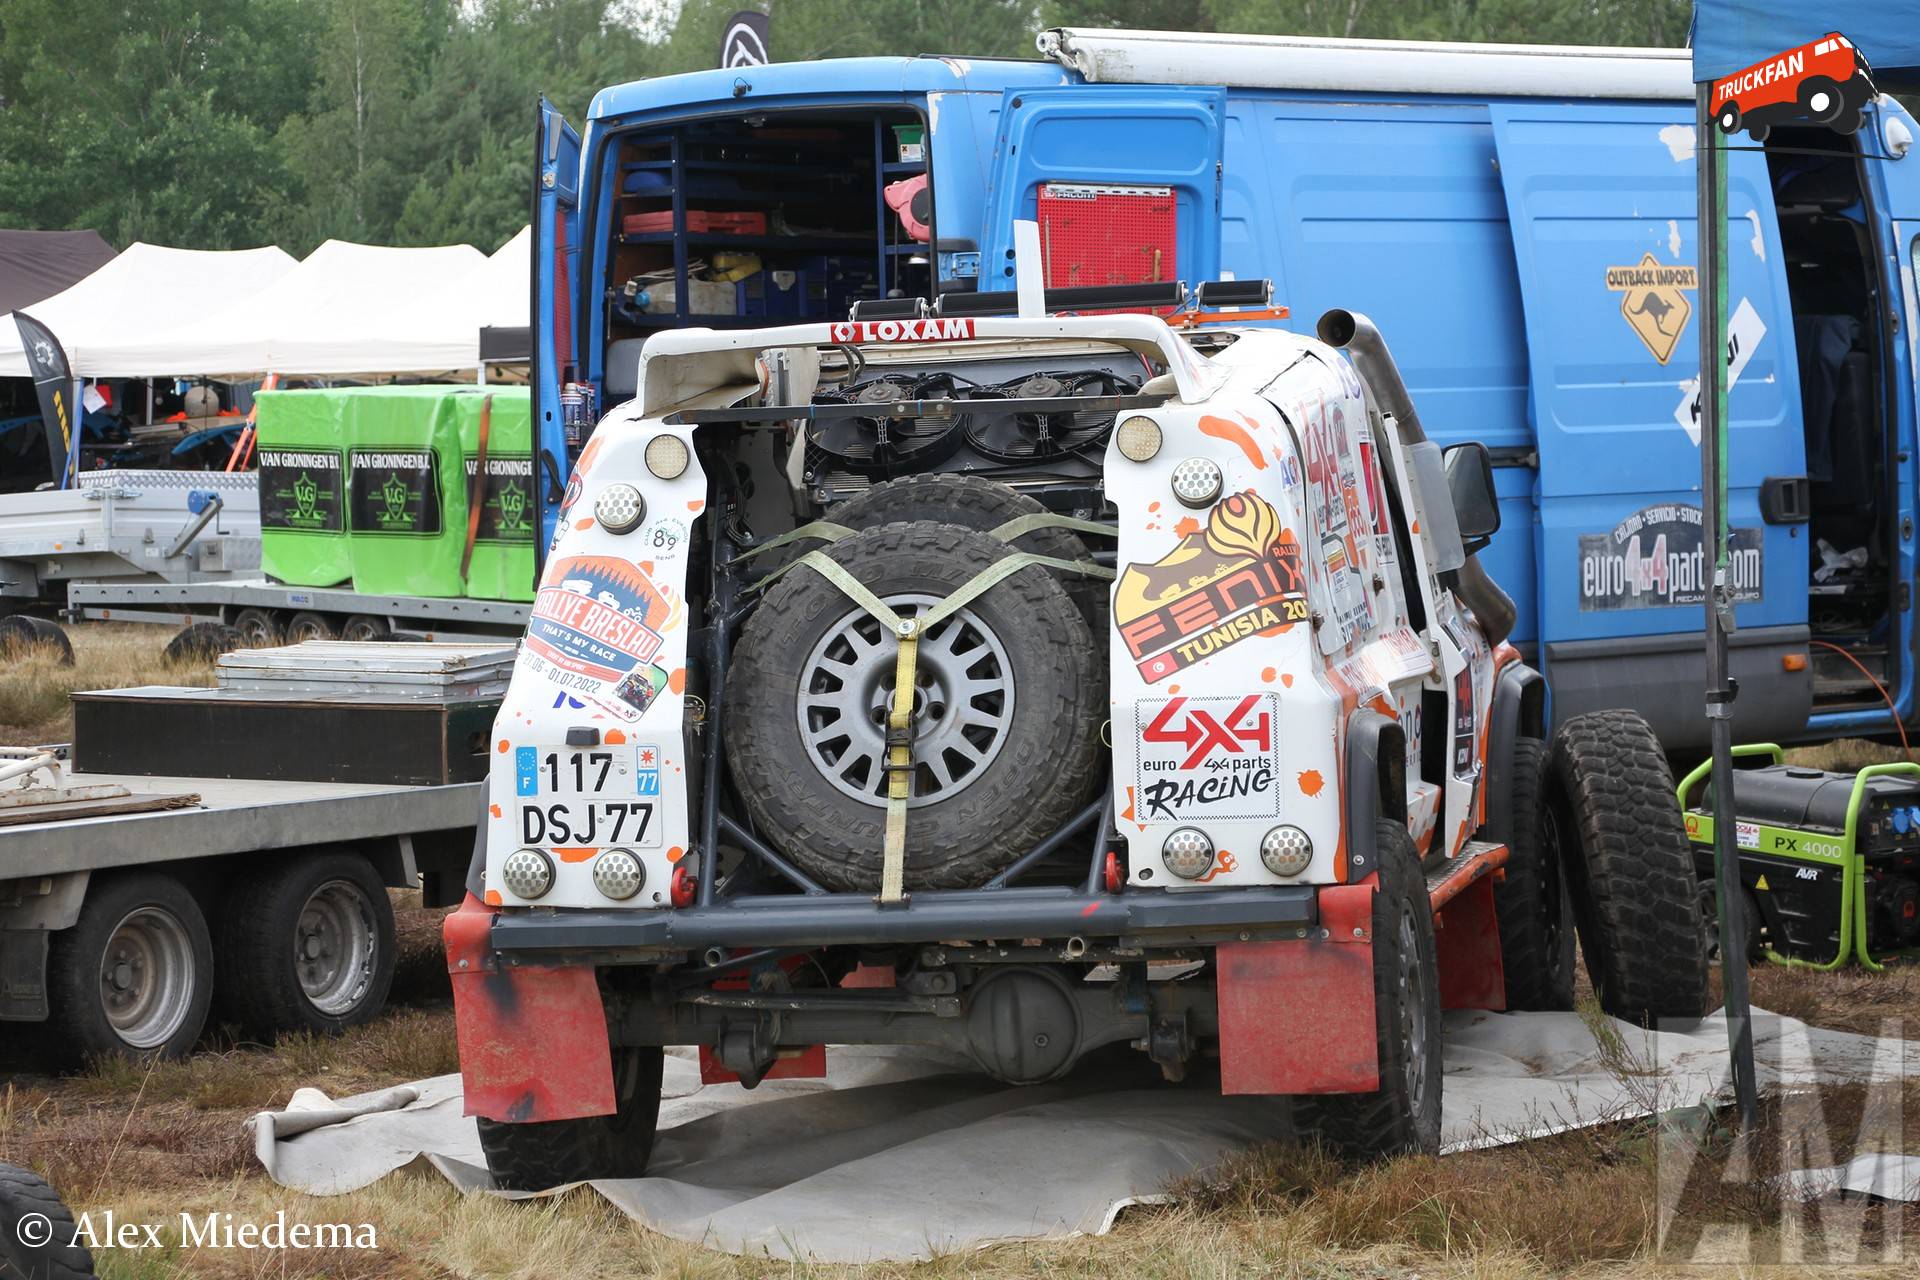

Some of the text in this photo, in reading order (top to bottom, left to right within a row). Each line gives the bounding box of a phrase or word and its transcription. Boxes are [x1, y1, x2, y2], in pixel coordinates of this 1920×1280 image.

[1607, 269, 1696, 287] OUTBACK IMPORT
[863, 319, 970, 341] LOXAM
[260, 452, 280, 467] VAN
[281, 453, 328, 469] GRONINGEN
[352, 453, 371, 468] VAN
[371, 454, 418, 469] GRONINGEN
[1645, 506, 1676, 525] SERVICIO
[533, 590, 657, 658] RALLYE BRESLAU
[542, 623, 572, 641] THAT'S
[572, 636, 589, 648] MY
[590, 644, 617, 662] RACE
[1177, 608, 1280, 664] TUNISIA
[547, 667, 602, 694] 01.07.2022
[545, 752, 613, 792] 117
[1143, 760, 1177, 771] euro
[1232, 756, 1272, 773] parts
[522, 777, 531, 789] F
[638, 773, 658, 791] 77
[1775, 837, 1842, 858] PX 4000
[1796, 868, 1818, 881] AVR
